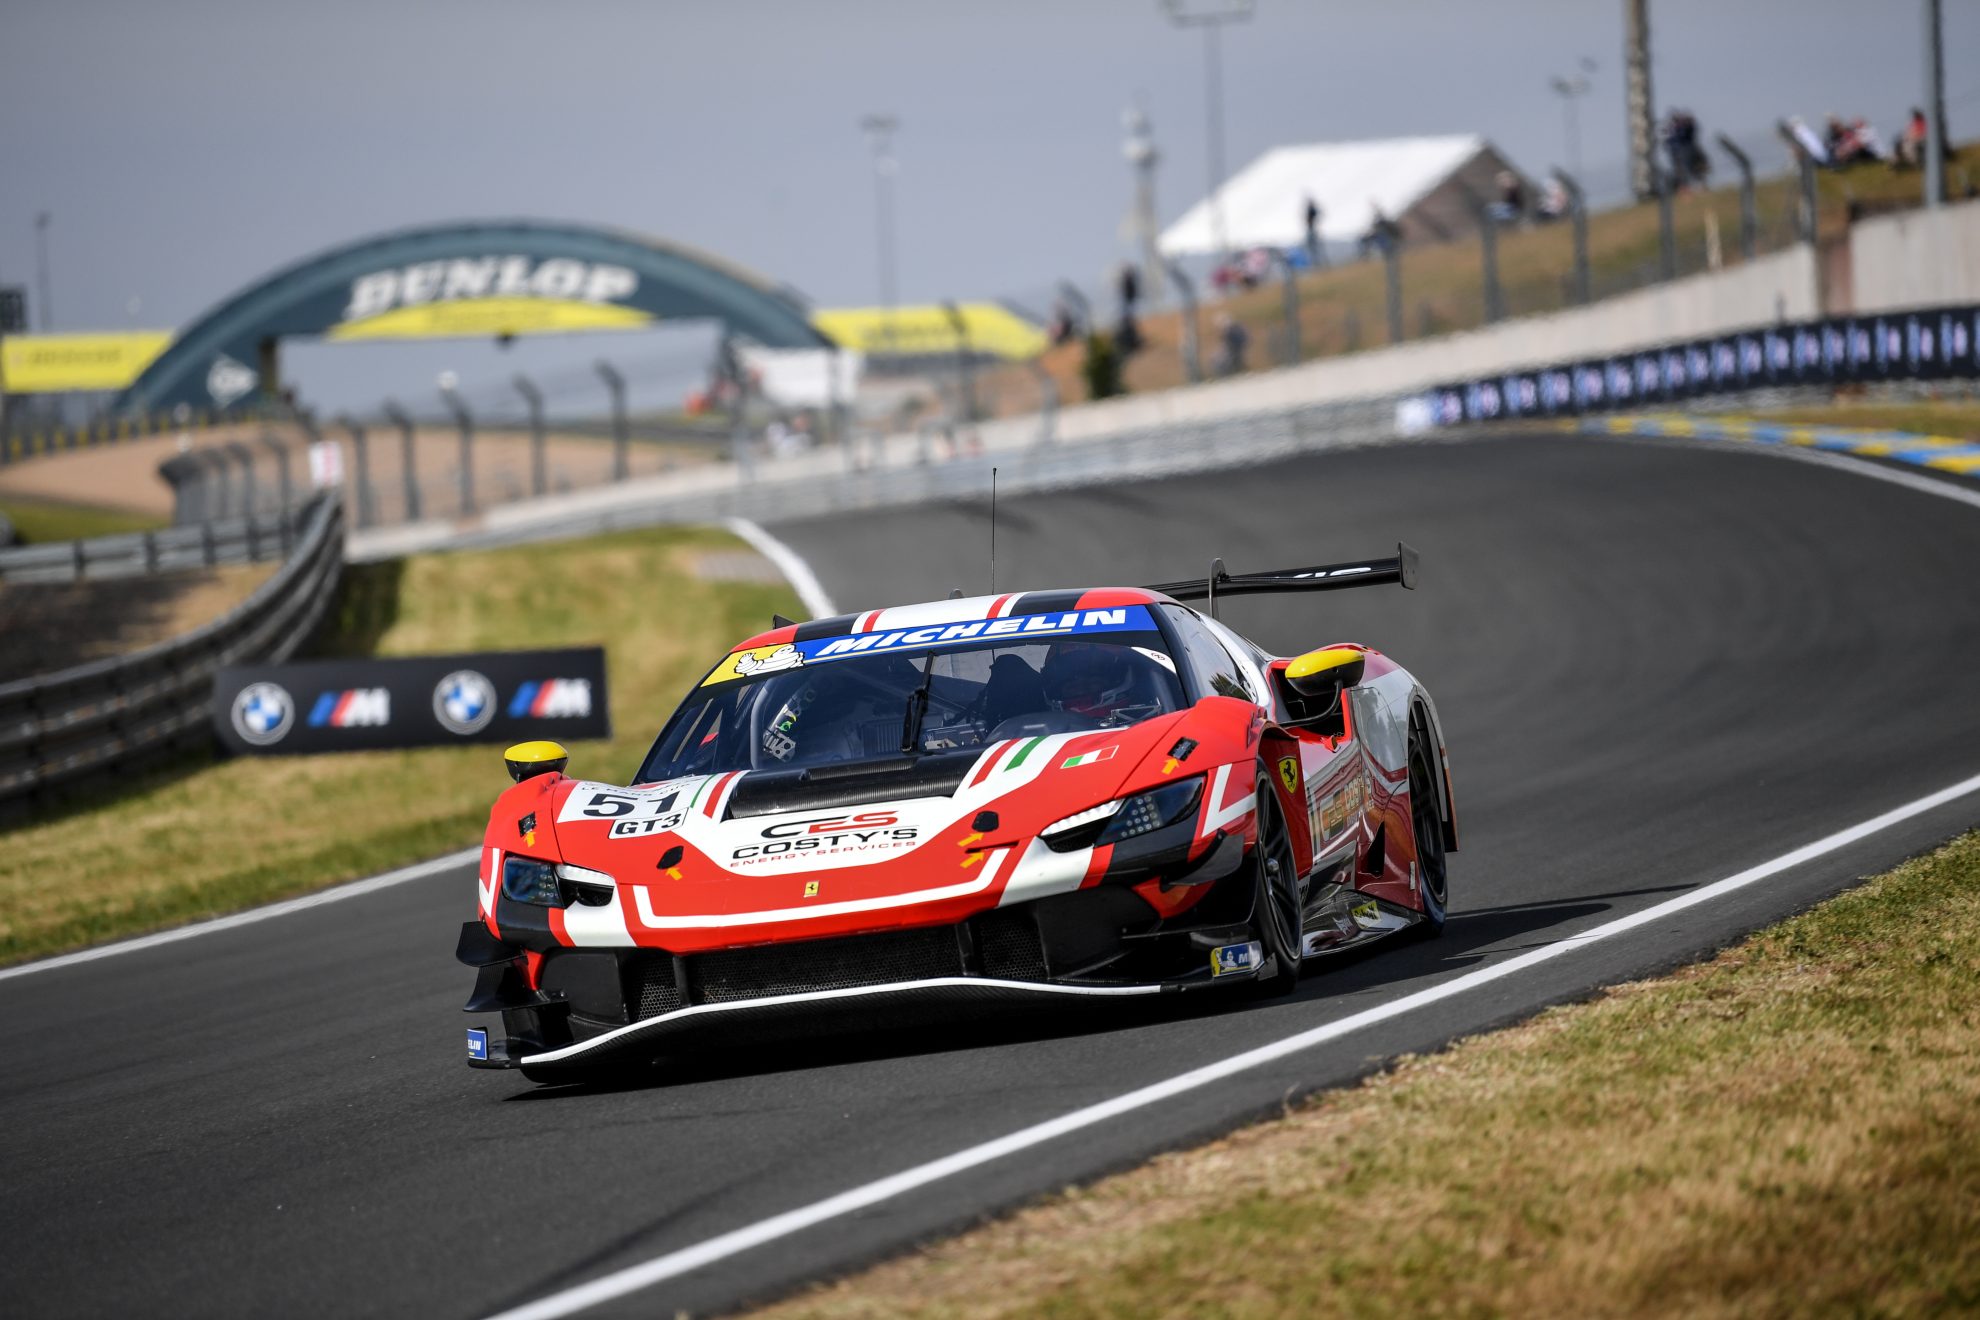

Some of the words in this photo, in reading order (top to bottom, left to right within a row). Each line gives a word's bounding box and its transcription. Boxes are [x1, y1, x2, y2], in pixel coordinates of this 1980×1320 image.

[342, 255, 639, 320] DUNLOP
[815, 609, 1126, 656] MICHELIN
[583, 790, 681, 817] 51
[615, 813, 682, 835] GT3
[761, 811, 899, 838] CES
[730, 851, 810, 868] ENERGY
[816, 841, 917, 855] SERVICES
[732, 828, 918, 859] COSTY'S
